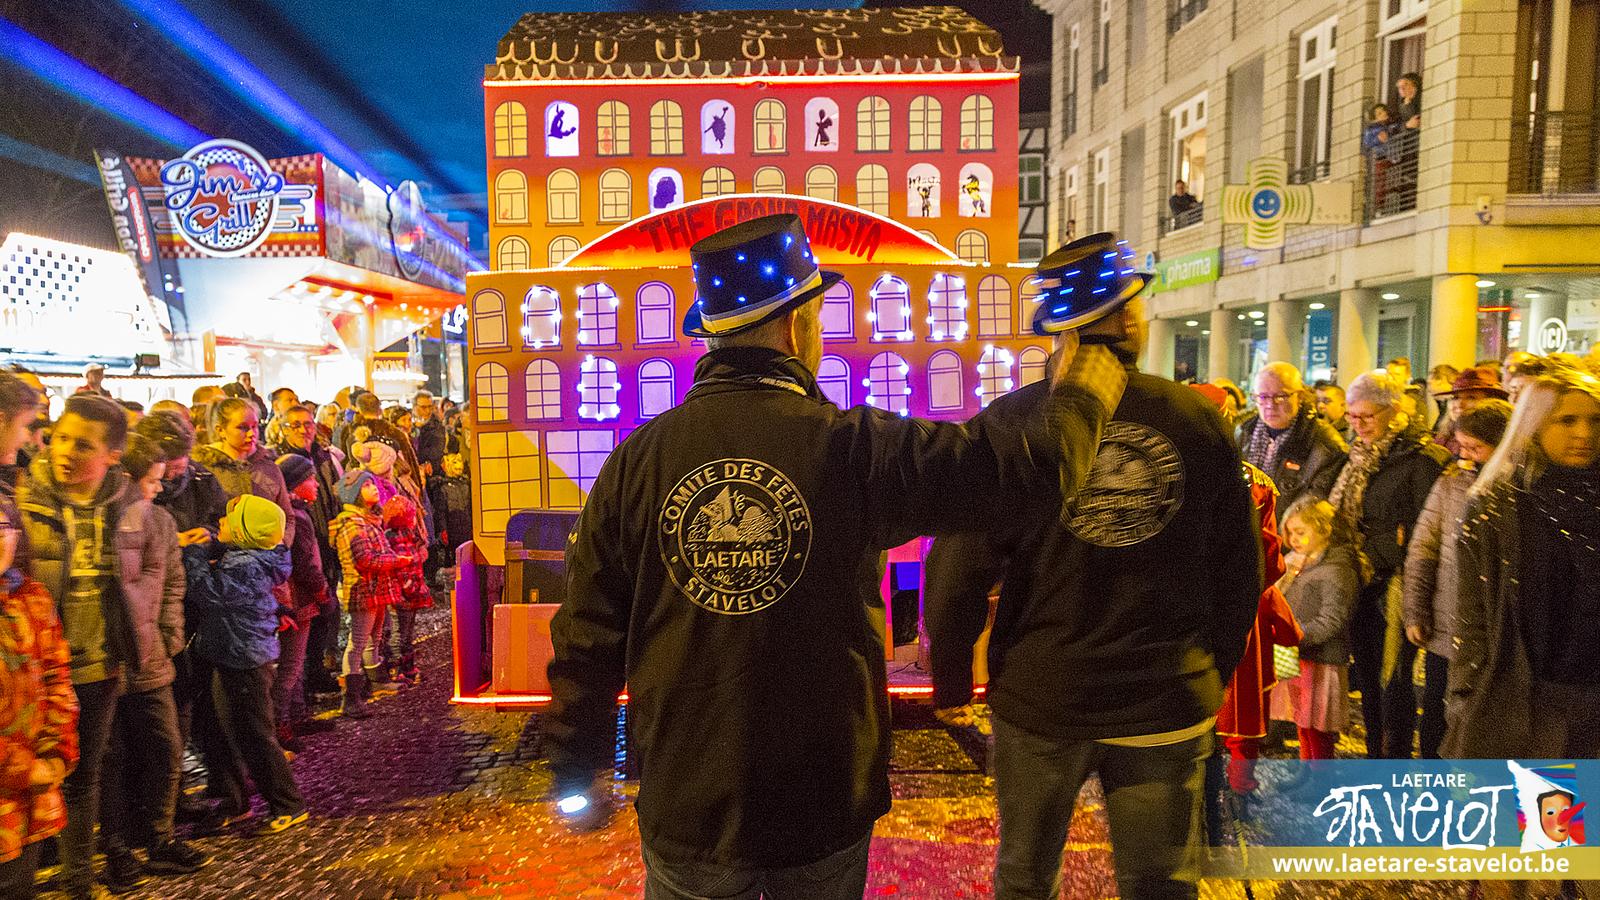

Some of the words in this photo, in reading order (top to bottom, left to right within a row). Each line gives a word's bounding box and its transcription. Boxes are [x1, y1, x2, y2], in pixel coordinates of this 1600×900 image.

[160, 157, 284, 211] Jim's
[184, 202, 257, 245] Grill
[639, 207, 705, 252] THE
[807, 205, 882, 262] MASTA
[1542, 327, 1561, 349] ICI
[662, 466, 718, 535] COMITE
[724, 463, 766, 482] DES
[766, 476, 809, 532] FETES
[693, 549, 778, 568] LAETARE
[684, 573, 788, 611] STAVELOT
